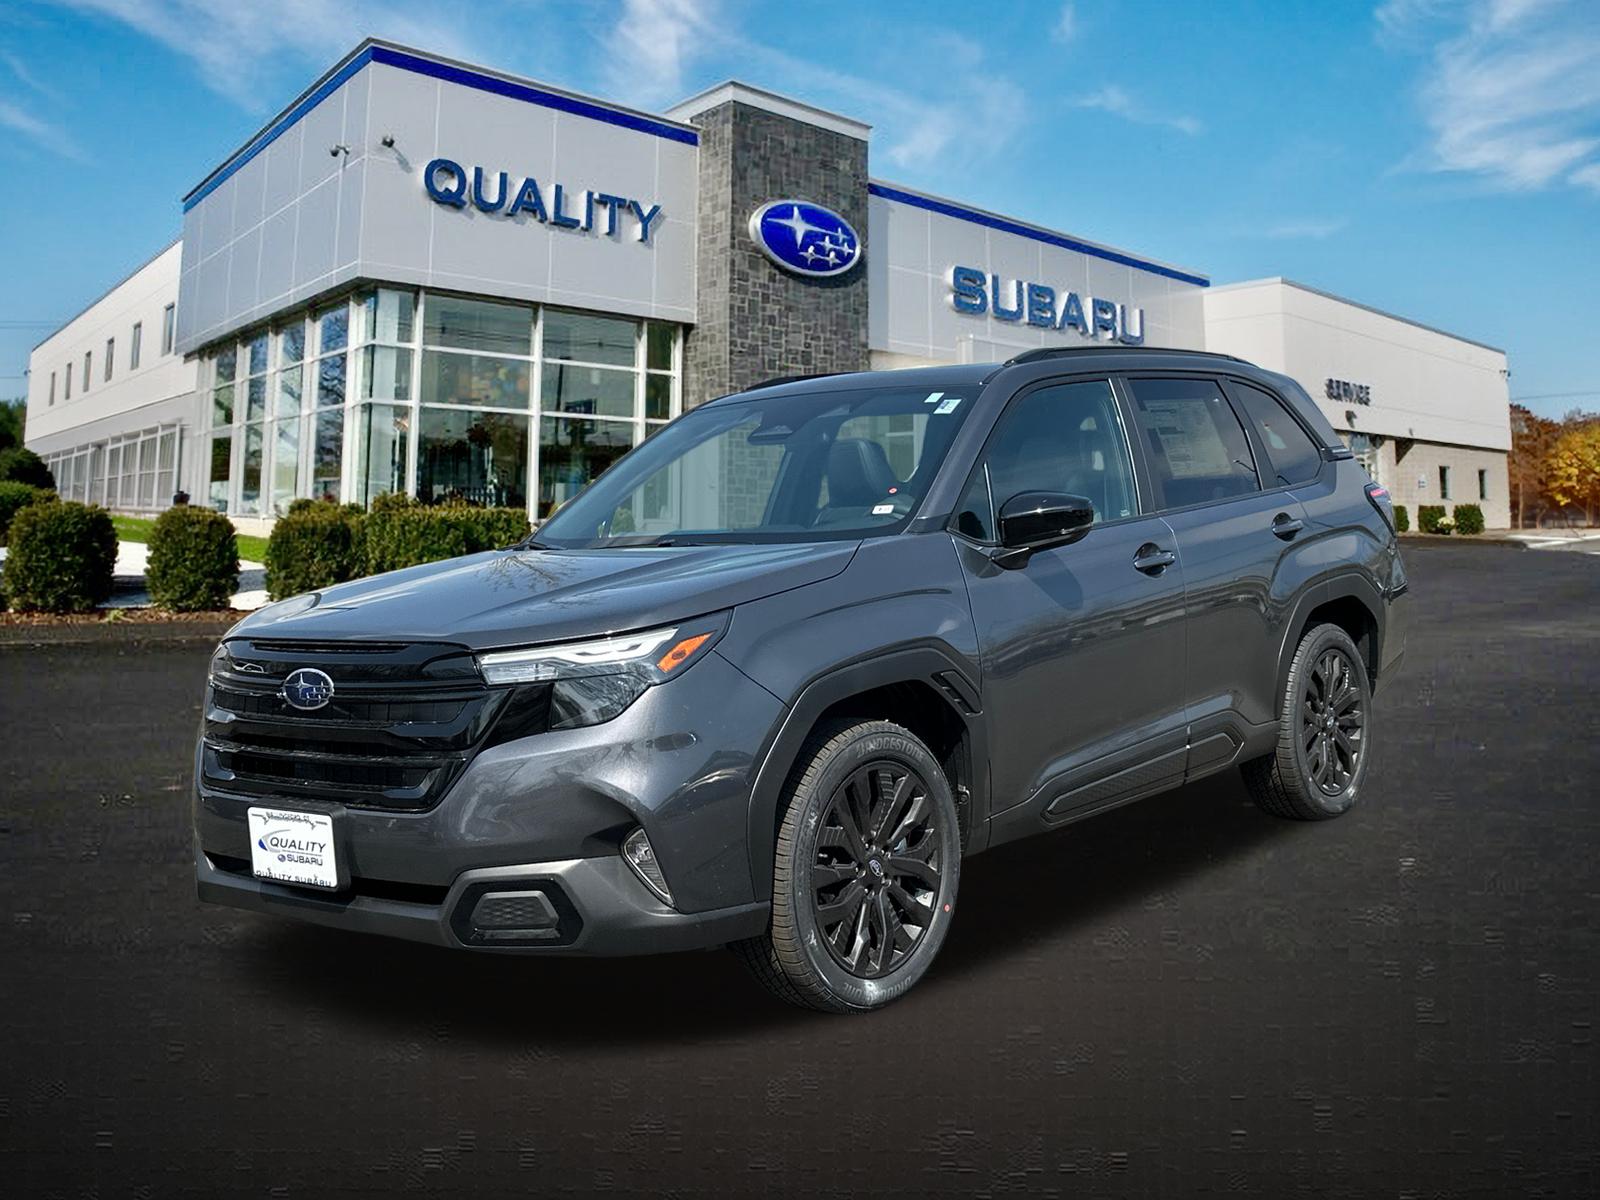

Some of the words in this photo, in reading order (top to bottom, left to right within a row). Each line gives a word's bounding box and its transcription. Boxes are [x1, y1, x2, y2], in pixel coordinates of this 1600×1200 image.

[424, 158, 661, 243] QUALITY
[951, 265, 1144, 346] SUBARU
[270, 836, 326, 852] QUALITY
[286, 853, 323, 866] SUBARU
[256, 869, 292, 881] QUALITY
